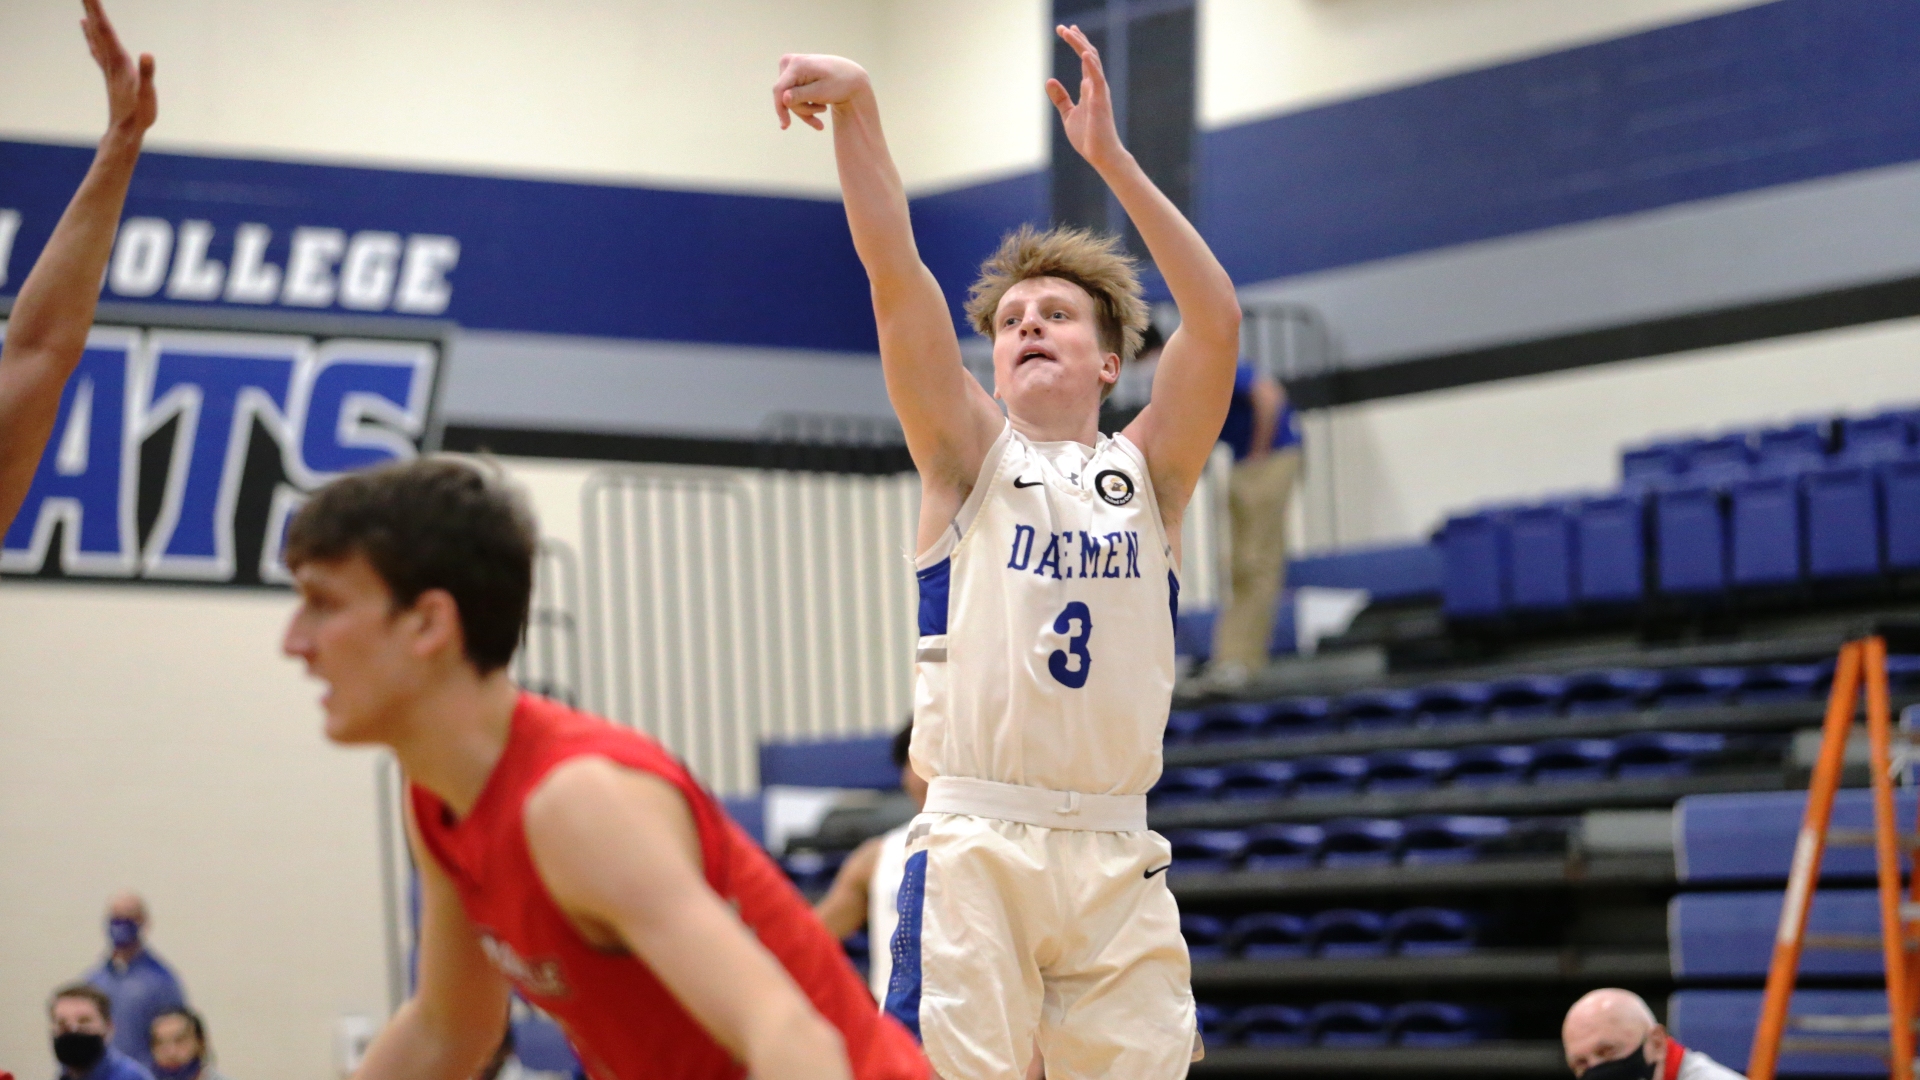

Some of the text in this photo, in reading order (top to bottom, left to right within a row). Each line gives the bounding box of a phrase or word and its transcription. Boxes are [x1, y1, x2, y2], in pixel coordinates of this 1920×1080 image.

[102, 216, 460, 314] OLLEGE
[1007, 523, 1141, 580] DAEMEN
[1048, 601, 1093, 689] 3
